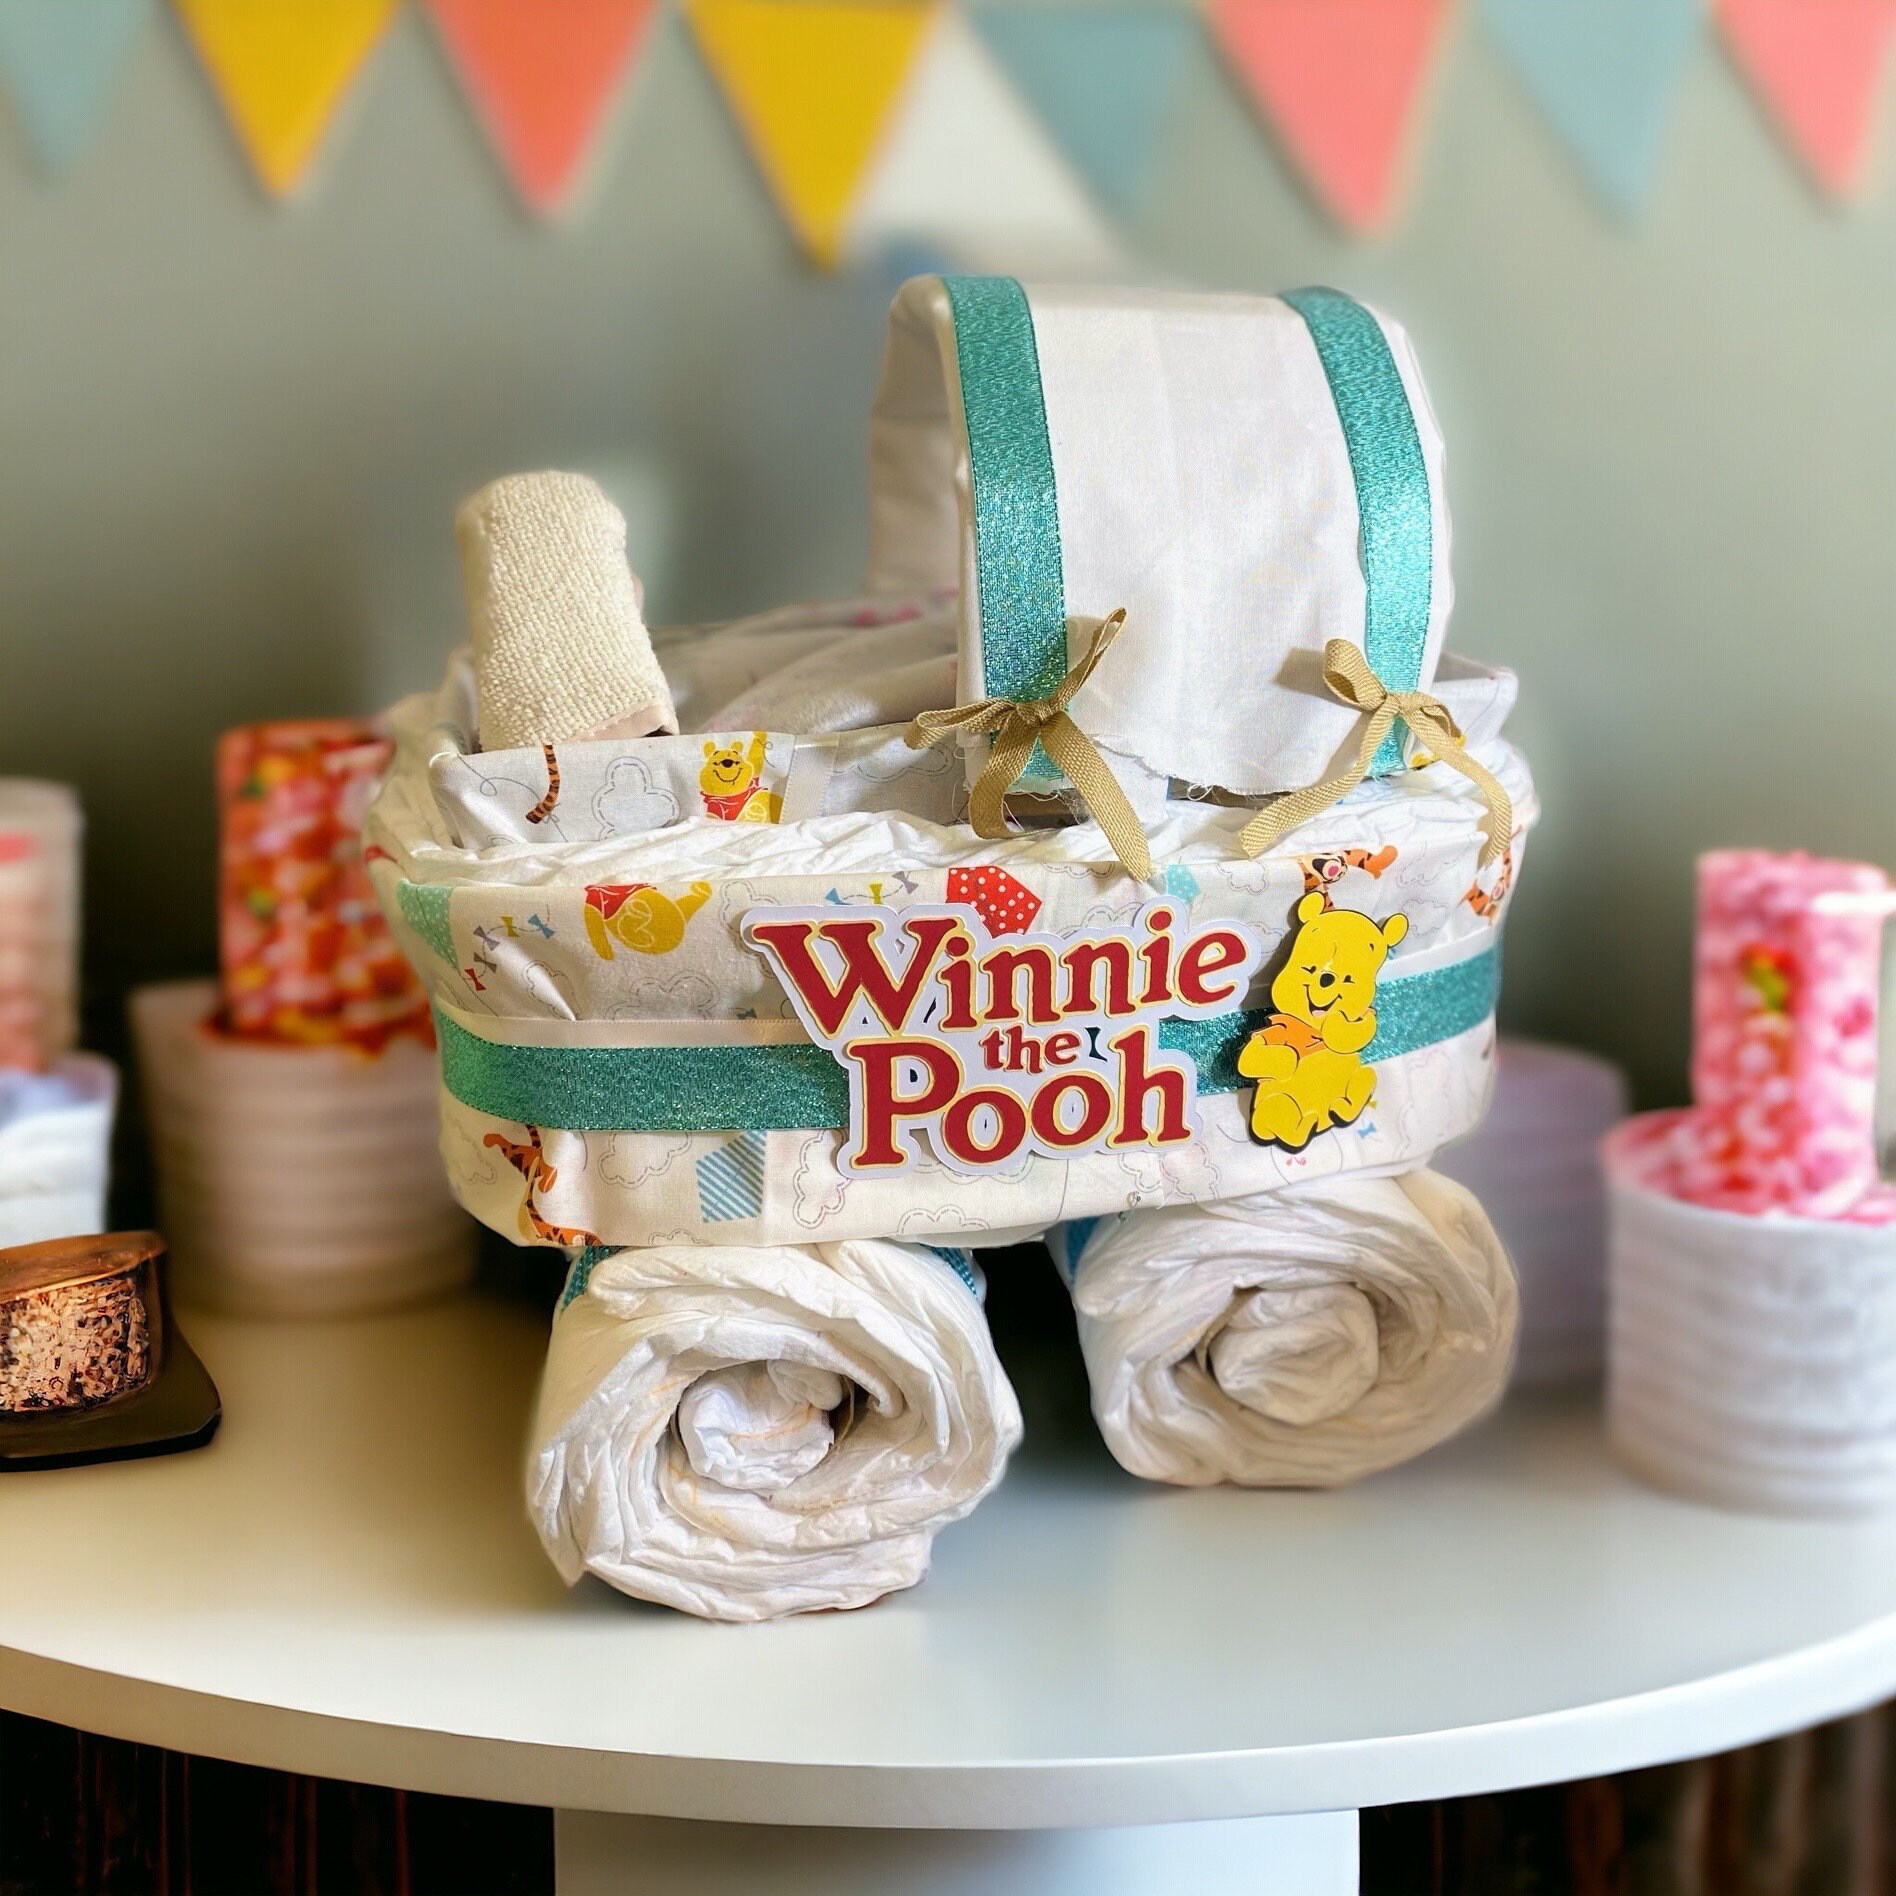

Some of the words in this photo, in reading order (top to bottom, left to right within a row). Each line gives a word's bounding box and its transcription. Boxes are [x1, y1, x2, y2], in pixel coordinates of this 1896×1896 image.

[751, 909, 1248, 1034] Winnie
[849, 1028, 1192, 1168] Pooh
[980, 1025, 1080, 1074] the
